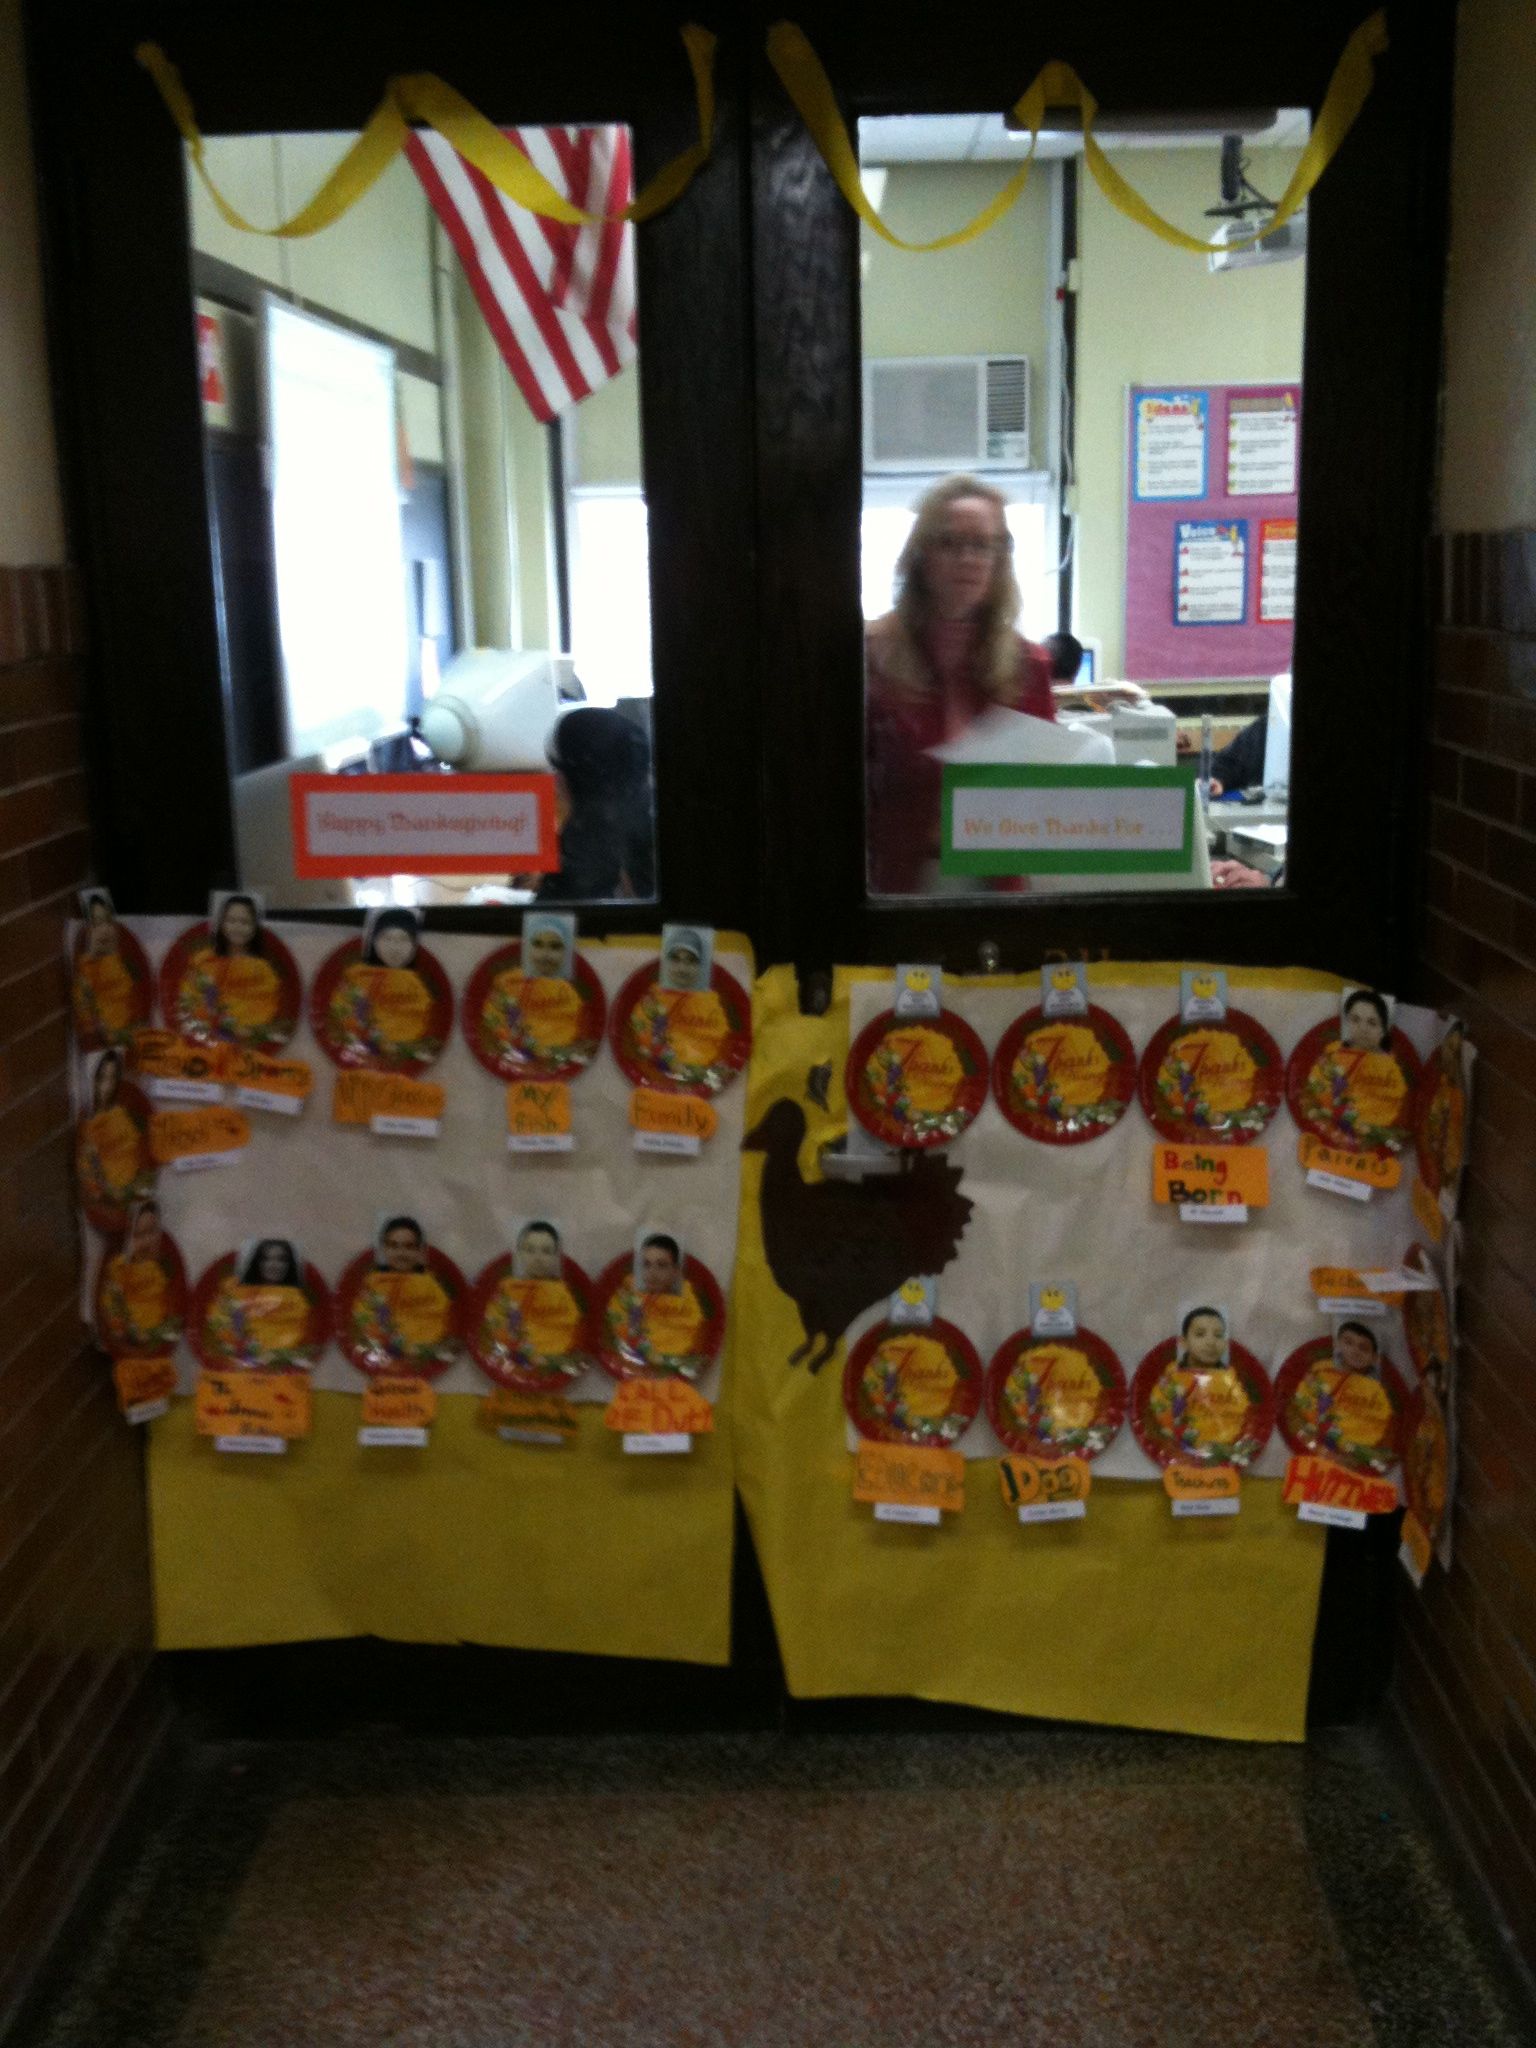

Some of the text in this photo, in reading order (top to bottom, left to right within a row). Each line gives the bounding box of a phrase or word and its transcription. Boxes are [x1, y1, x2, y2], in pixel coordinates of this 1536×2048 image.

[963, 816, 1143, 836] We Give Thanks For
[1163, 1150, 1228, 1184] Being
[1168, 1180, 1243, 1204] Born
